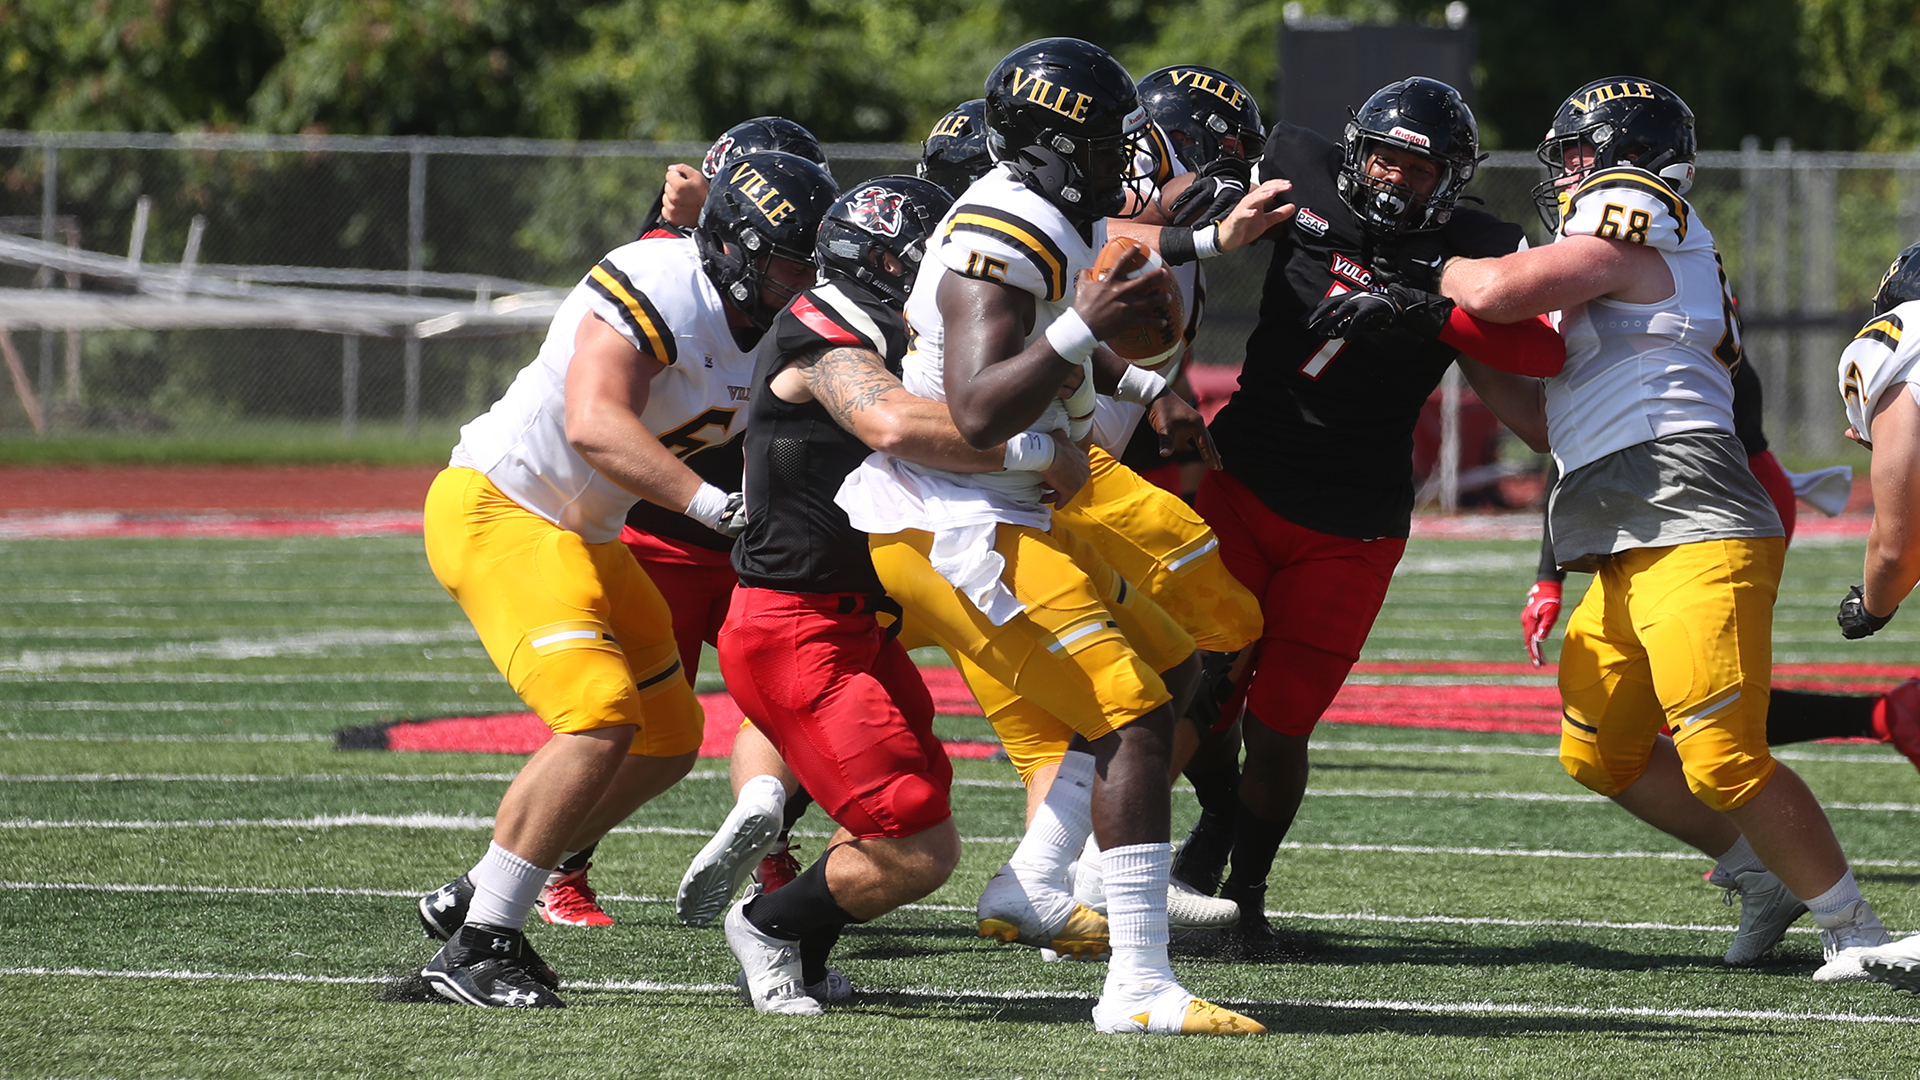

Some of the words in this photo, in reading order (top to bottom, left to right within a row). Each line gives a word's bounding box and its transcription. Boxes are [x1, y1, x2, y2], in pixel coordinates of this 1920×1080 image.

[1012, 67, 1093, 124] VILLE
[1168, 70, 1247, 111] VILLE
[1568, 82, 1655, 112] VILLE
[1394, 129, 1428, 146] Riddell
[729, 162, 796, 227] VILLE
[1297, 213, 1327, 232] PSAC
[1596, 202, 1652, 246] 68
[965, 250, 1010, 283] 15
